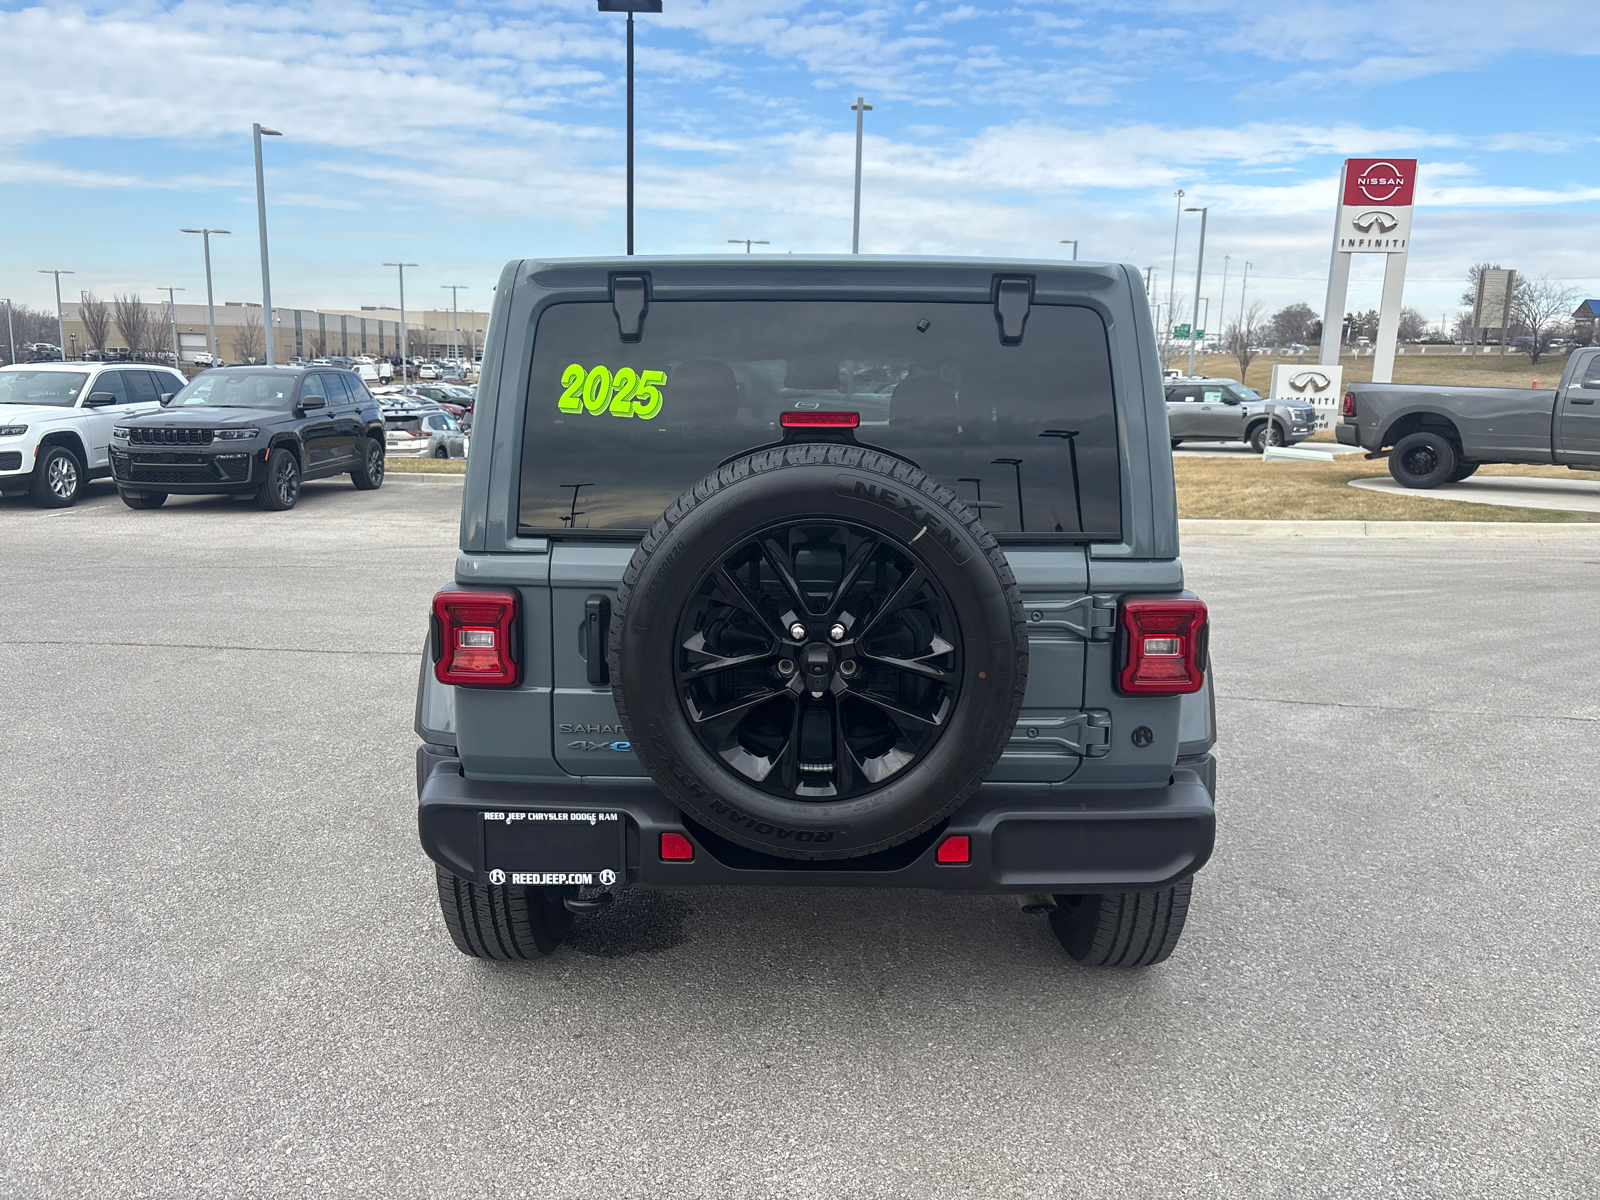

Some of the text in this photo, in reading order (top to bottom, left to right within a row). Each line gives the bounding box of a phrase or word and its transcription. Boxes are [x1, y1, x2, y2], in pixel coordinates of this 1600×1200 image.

[1341, 239, 1405, 248] INFINITI
[557, 363, 668, 420] 2025
[853, 480, 960, 547] NEXEN
[645, 540, 685, 603] 255/60R20
[558, 723, 625, 734] SAHAR
[484, 812, 618, 821] REED JEEP CHRYSLER DODGE RAM
[707, 798, 834, 843] ROADIAN
[512, 873, 592, 885] REEDJEEP.COM
